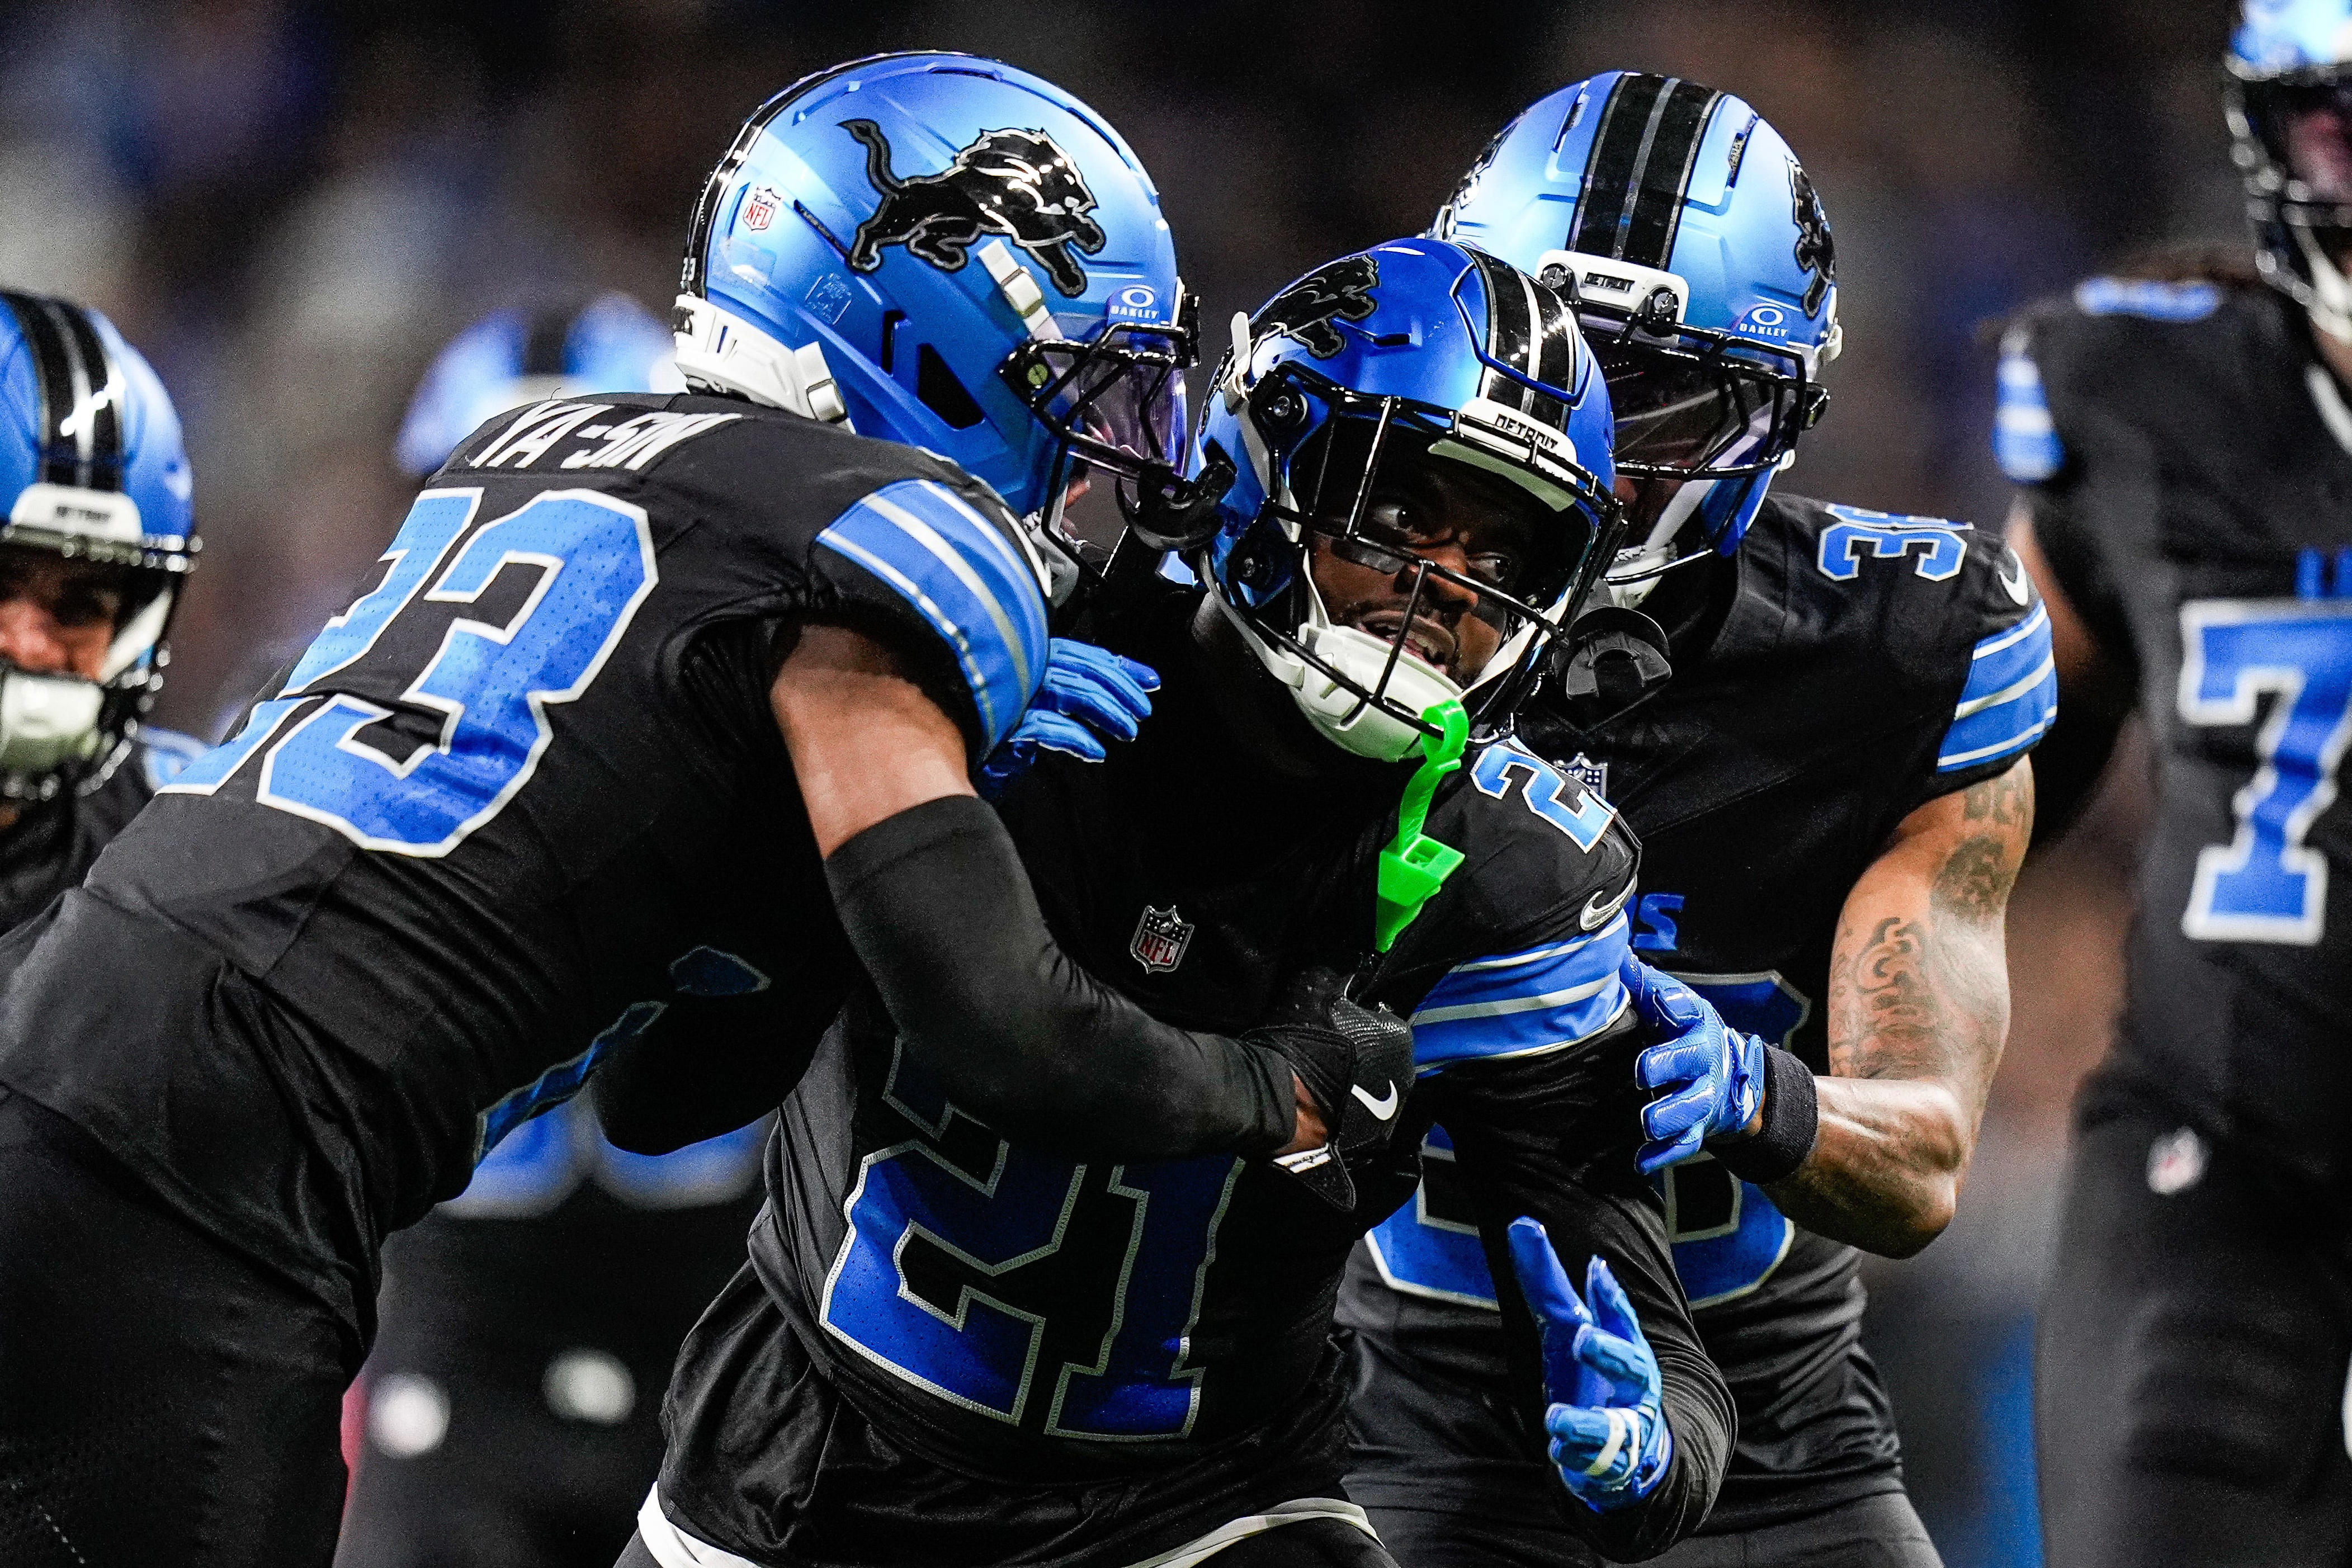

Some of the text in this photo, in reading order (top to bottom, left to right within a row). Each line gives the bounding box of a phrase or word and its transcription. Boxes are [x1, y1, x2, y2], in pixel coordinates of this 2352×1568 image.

[745, 202, 769, 226] NFL
[1110, 305, 1159, 319] OAKLEY
[1739, 323, 1788, 337] OAKLEY
[469, 399, 743, 471] YA-SIN
[1818, 503, 1975, 582] 3
[1470, 734, 1618, 854] 2
[1137, 931, 1174, 964] NFL
[819, 1037, 1246, 1442] 21
